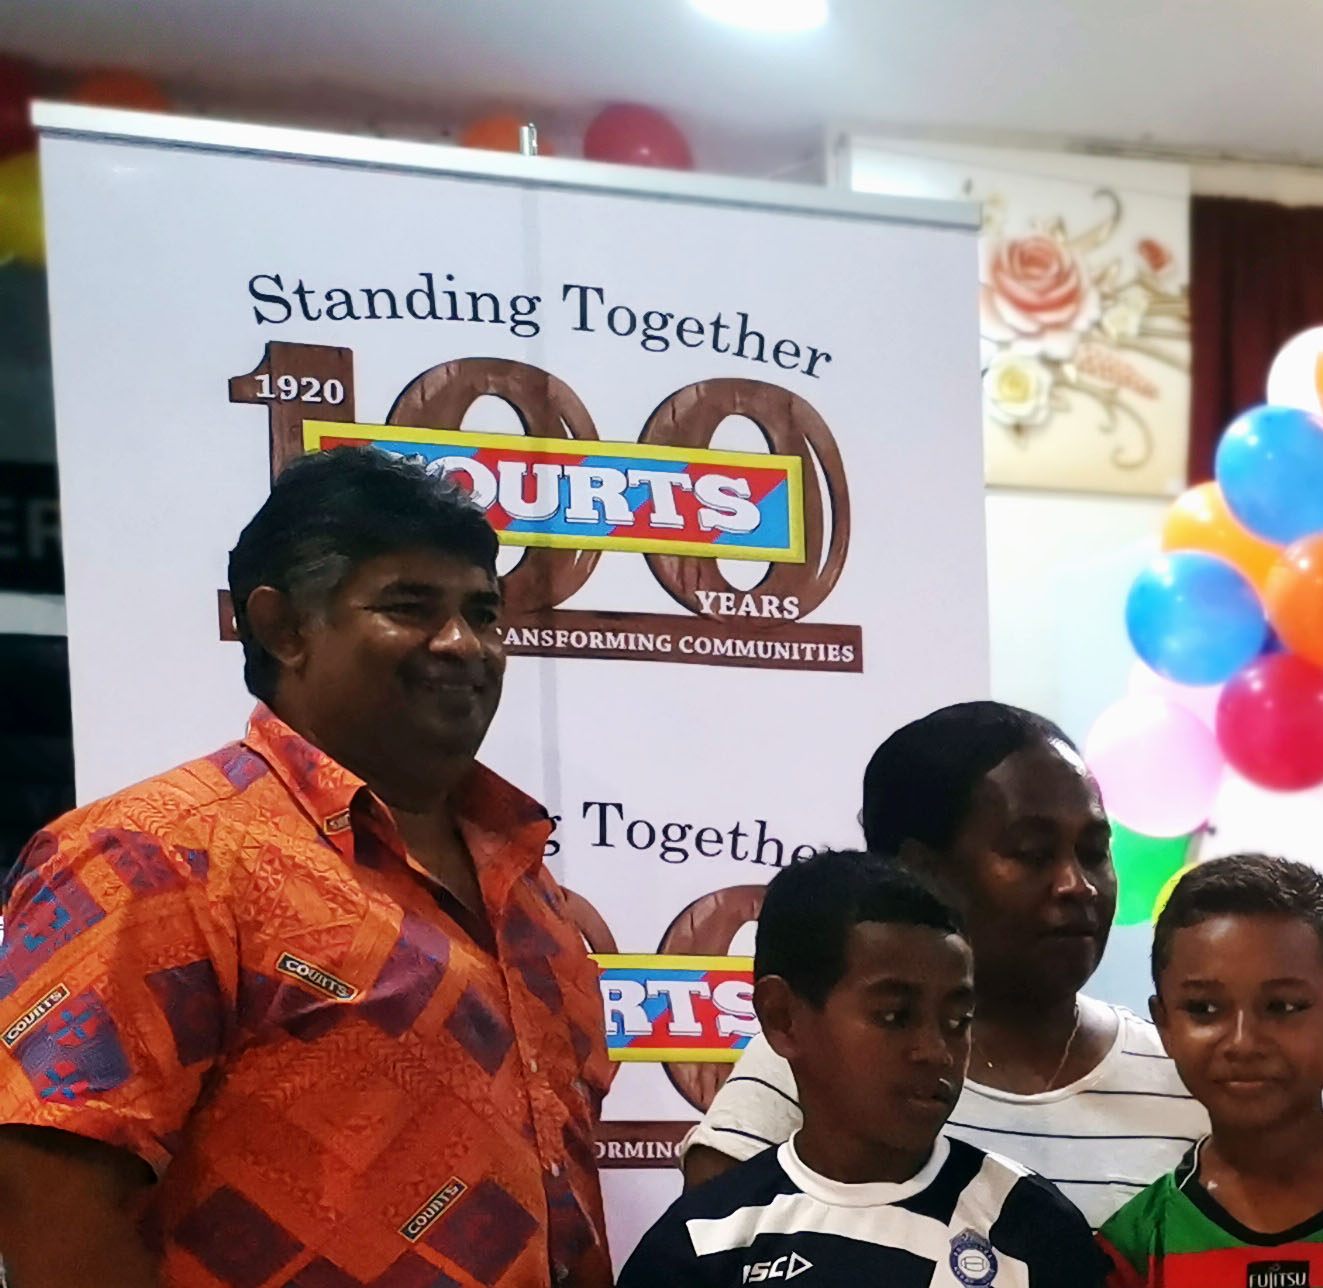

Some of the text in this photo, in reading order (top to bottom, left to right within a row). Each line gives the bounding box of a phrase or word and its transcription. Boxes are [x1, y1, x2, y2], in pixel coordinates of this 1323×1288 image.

[249, 273, 832, 379] Standing Together
[254, 374, 344, 405] 1920
[425, 455, 761, 534] OURTS
[694, 590, 801, 619] YEARS
[499, 626, 855, 662] ANSFORMING COMMUNITIES
[582, 801, 822, 868] Togethe
[285, 960, 349, 997] COURTS
[6, 991, 63, 1040] COURTS
[407, 1185, 460, 1234] COURTS
